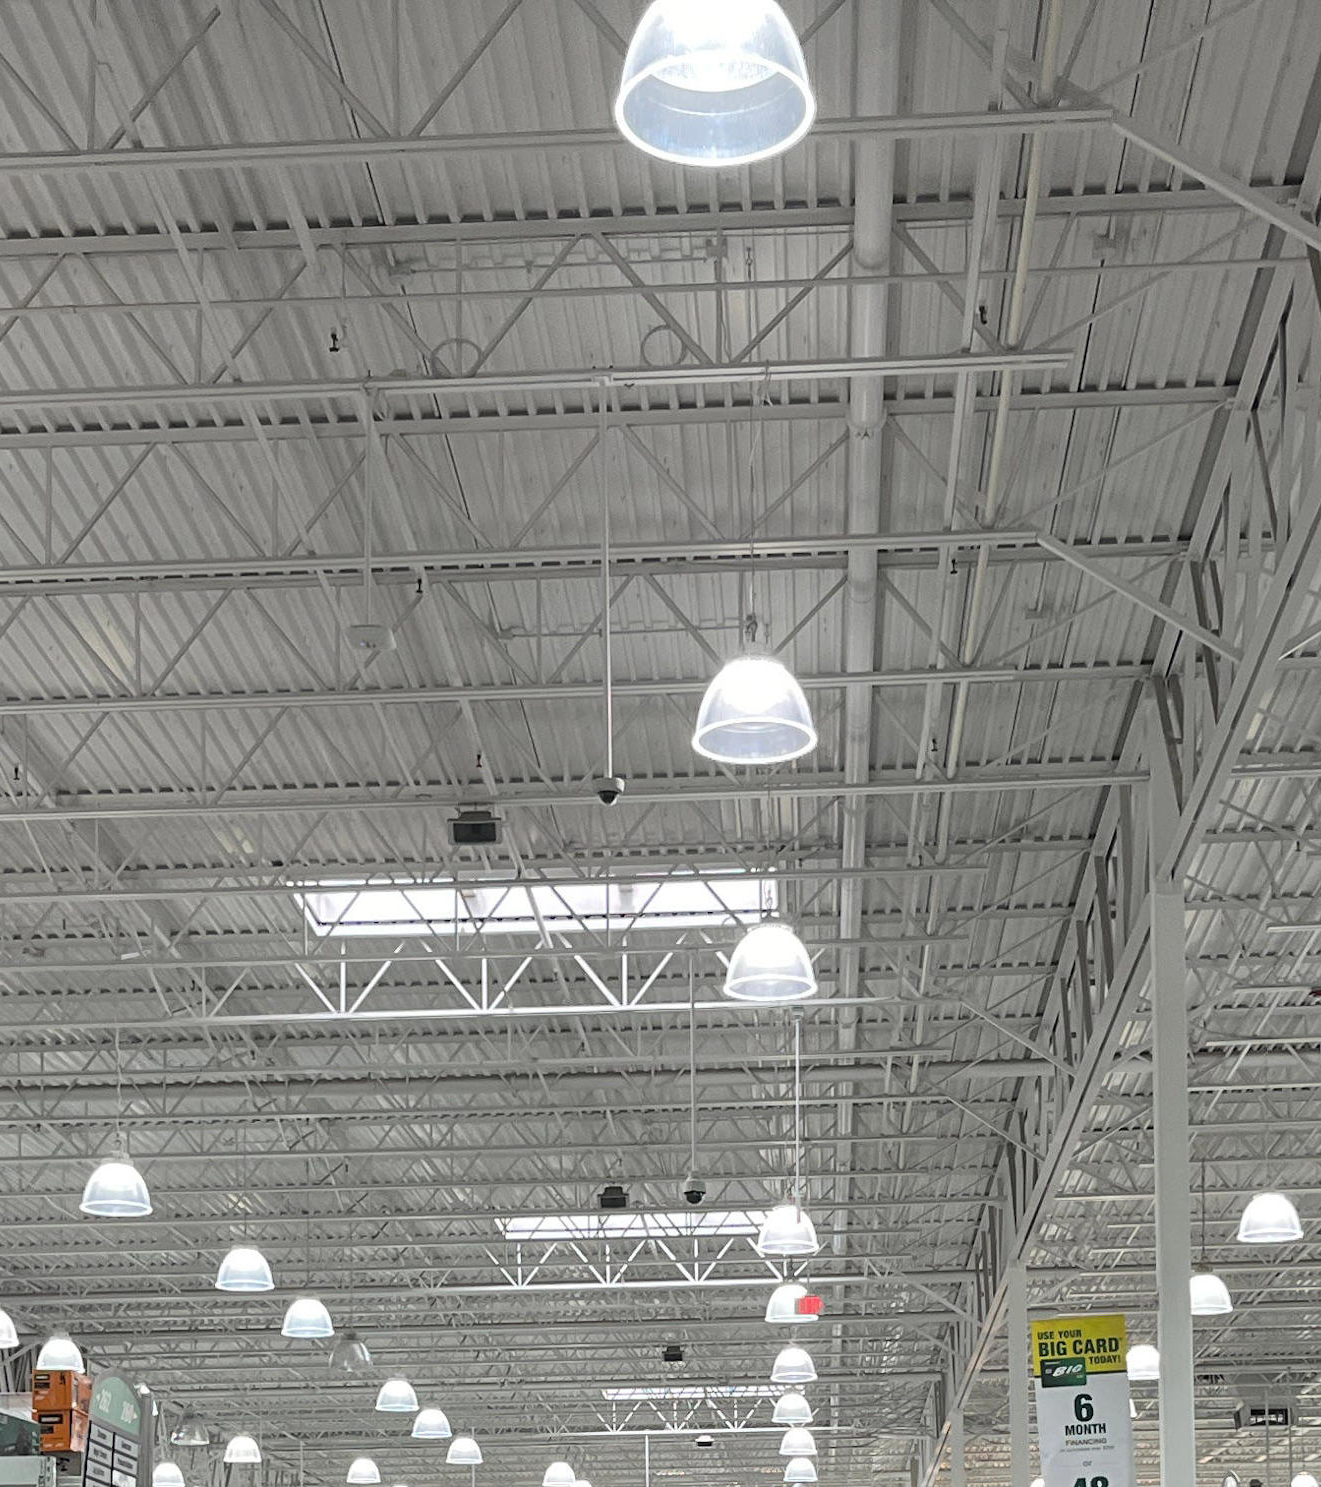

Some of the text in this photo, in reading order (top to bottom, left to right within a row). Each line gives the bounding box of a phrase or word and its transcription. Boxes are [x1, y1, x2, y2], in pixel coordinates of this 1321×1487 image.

[1037, 1330, 1082, 1340] USE YOUR
[1039, 1338, 1120, 1357] BIG CARD
[1089, 1355, 1121, 1364] TODAY!
[1074, 1393, 1094, 1422] 6
[1065, 1424, 1107, 1436] MONTH
